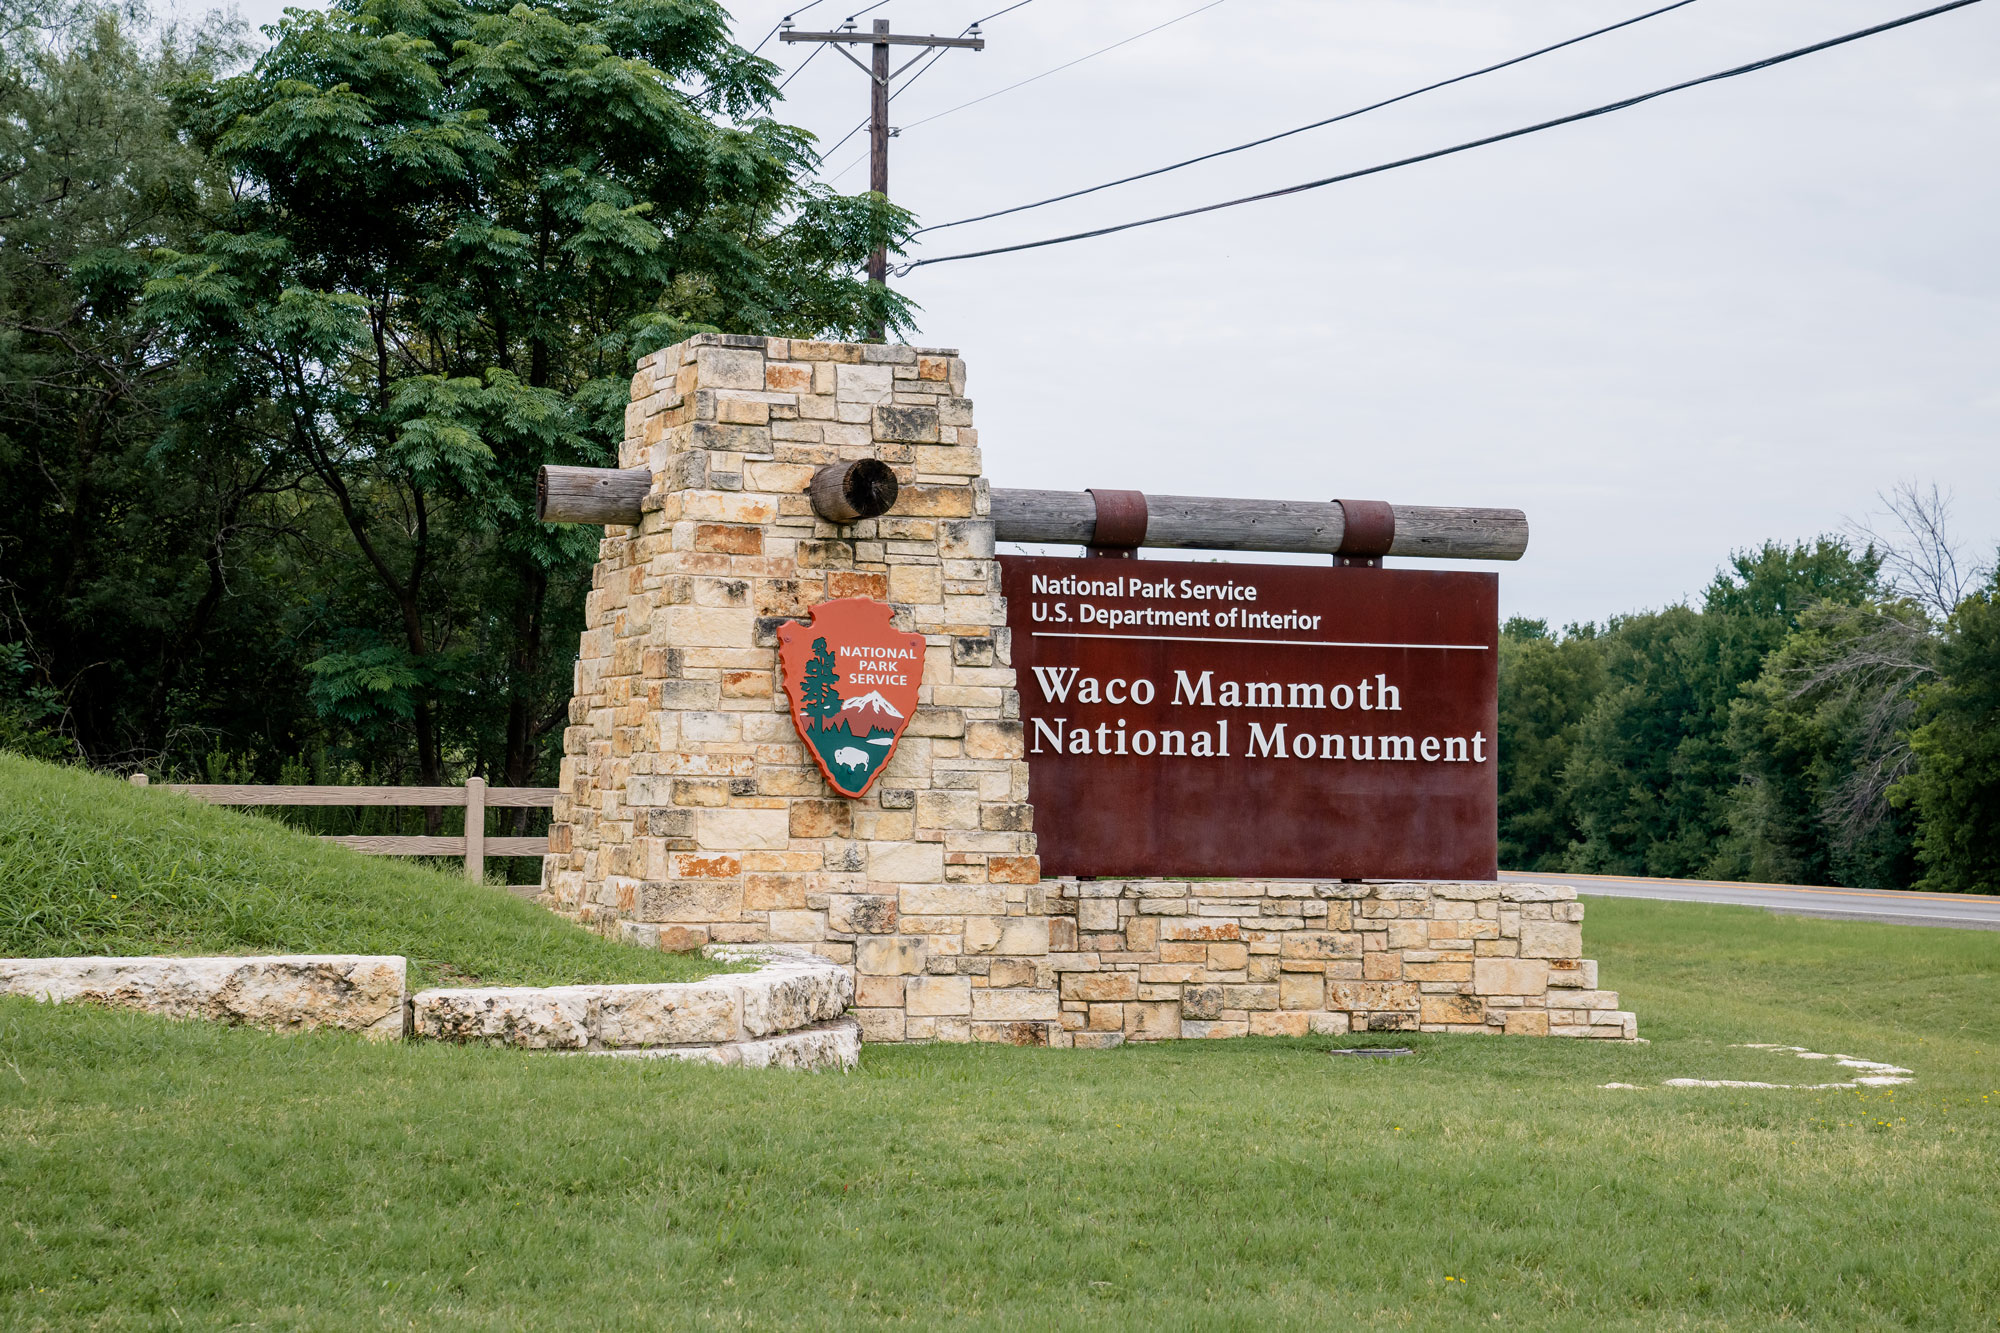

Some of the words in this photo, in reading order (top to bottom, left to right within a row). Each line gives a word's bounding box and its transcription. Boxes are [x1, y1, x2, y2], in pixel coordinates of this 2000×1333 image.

[1031, 574, 1124, 597] National
[1129, 577, 1176, 599] Park
[1180, 580, 1257, 602] Service
[1031, 602, 1074, 623] U.S.
[1079, 603, 1211, 630] Department
[1214, 607, 1238, 628] of
[1241, 608, 1322, 630] Interior
[840, 646, 917, 659] NATIONAL
[859, 660, 898, 672] PARK
[849, 673, 908, 686] SERVICE
[1031, 666, 1155, 705] Waco
[1170, 669, 1403, 710] Mammoth
[1029, 717, 1231, 757] National
[1244, 722, 1487, 762] Monument
